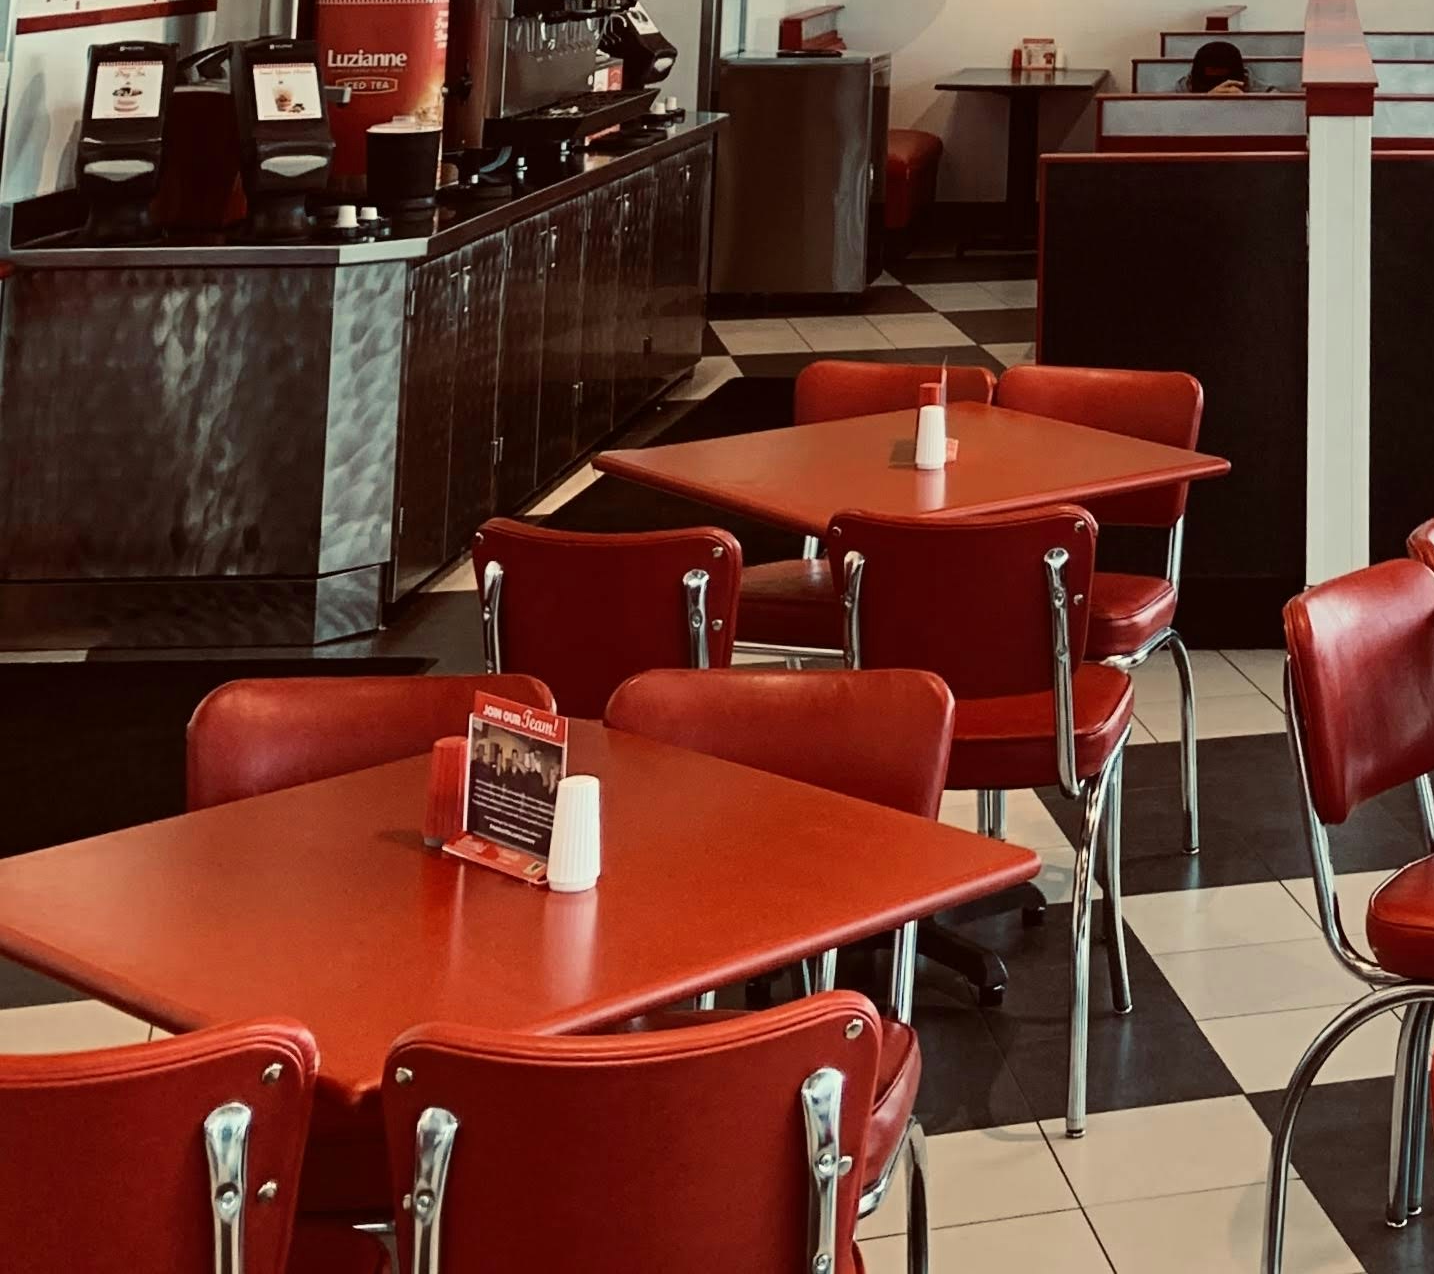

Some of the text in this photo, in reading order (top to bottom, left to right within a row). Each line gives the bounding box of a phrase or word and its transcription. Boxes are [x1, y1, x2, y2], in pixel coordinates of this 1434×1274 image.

[327, 49, 408, 67] Luzianne
[344, 80, 390, 90] ICED TEA
[483, 704, 558, 737] JOIN OUR Team!
